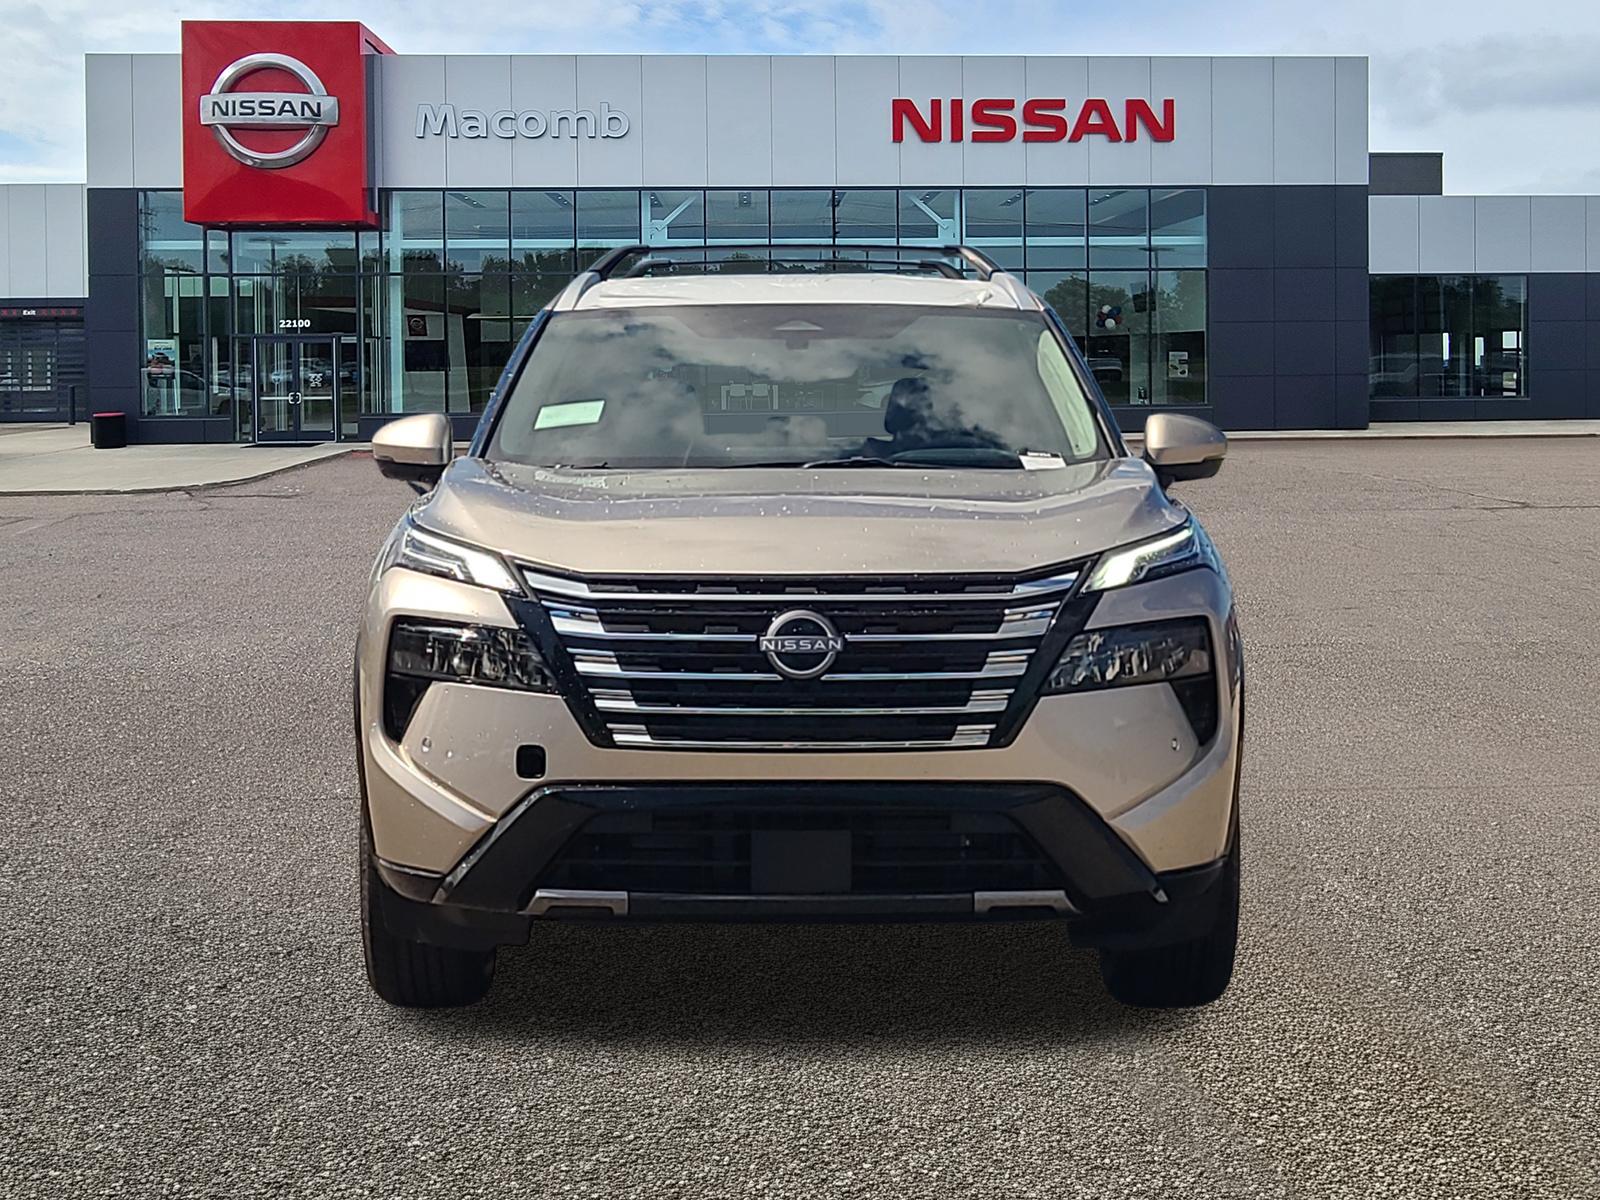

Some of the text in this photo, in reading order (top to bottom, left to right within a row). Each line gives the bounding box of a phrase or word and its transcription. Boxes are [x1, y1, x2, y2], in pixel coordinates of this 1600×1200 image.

[211, 100, 322, 117] NISSAN
[415, 102, 630, 139] Macomb
[892, 98, 1175, 143] NISSAN
[279, 319, 311, 328] 22100
[761, 639, 841, 650] NISSAN
